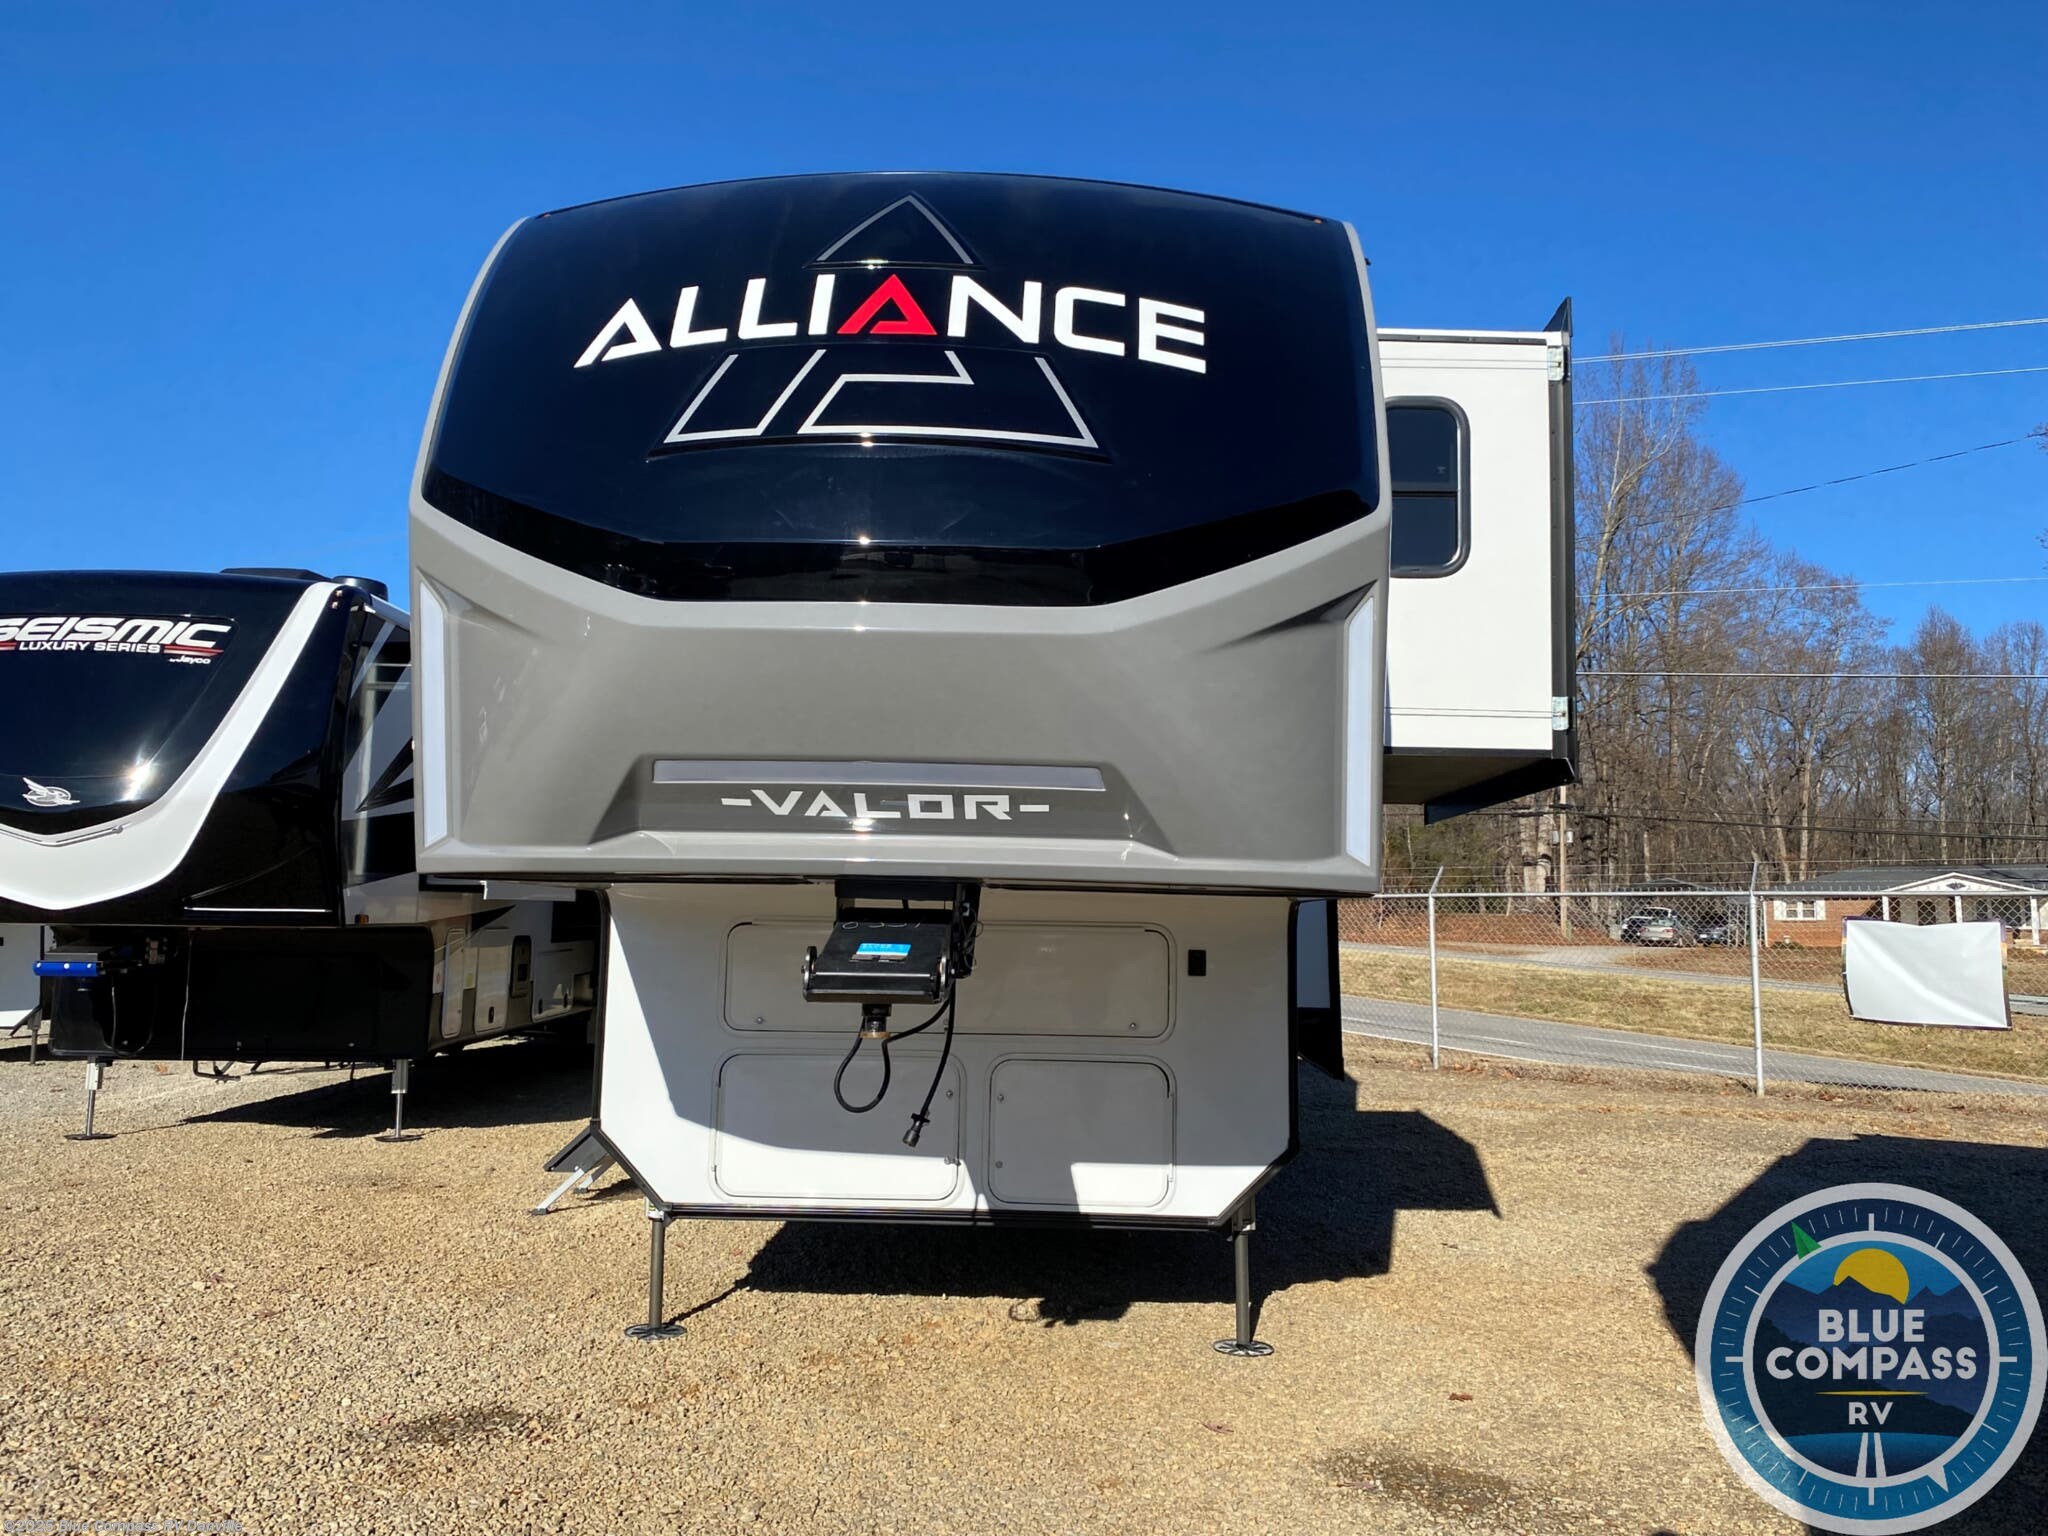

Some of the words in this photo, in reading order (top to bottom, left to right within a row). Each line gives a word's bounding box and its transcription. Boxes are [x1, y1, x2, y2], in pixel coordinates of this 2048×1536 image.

[573, 273, 1207, 374] ALLIANCE
[0, 616, 232, 648] SEISMIC
[19, 641, 90, 651] LUXURY
[93, 642, 161, 653] SERIES
[177, 654, 212, 665] Jayco
